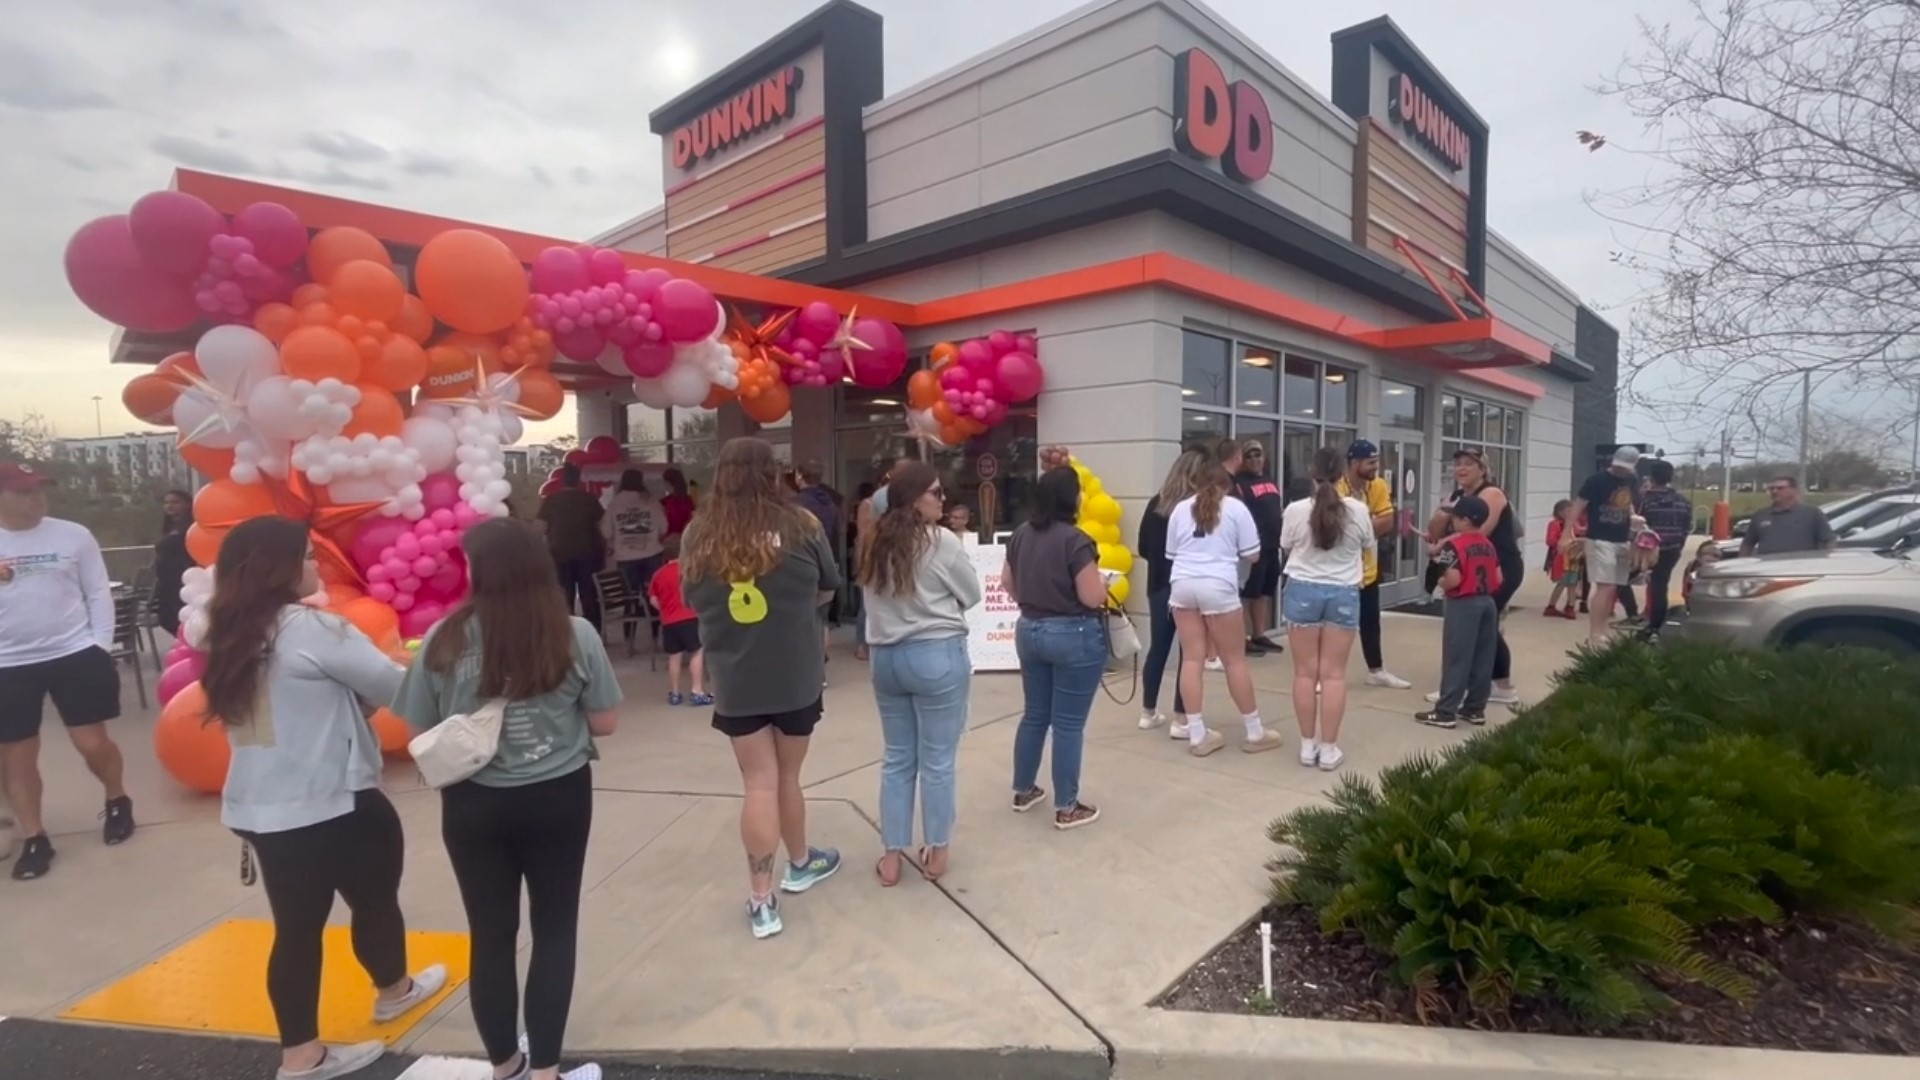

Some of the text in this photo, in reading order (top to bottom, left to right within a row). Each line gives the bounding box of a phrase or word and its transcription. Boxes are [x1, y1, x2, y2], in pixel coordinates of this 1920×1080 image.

[672, 66, 798, 169] DUNKIN'
[1181, 47, 1273, 183] DD
[985, 574, 1002, 583] DU
[985, 584, 1007, 593] MA
[985, 594, 1004, 604] ME
